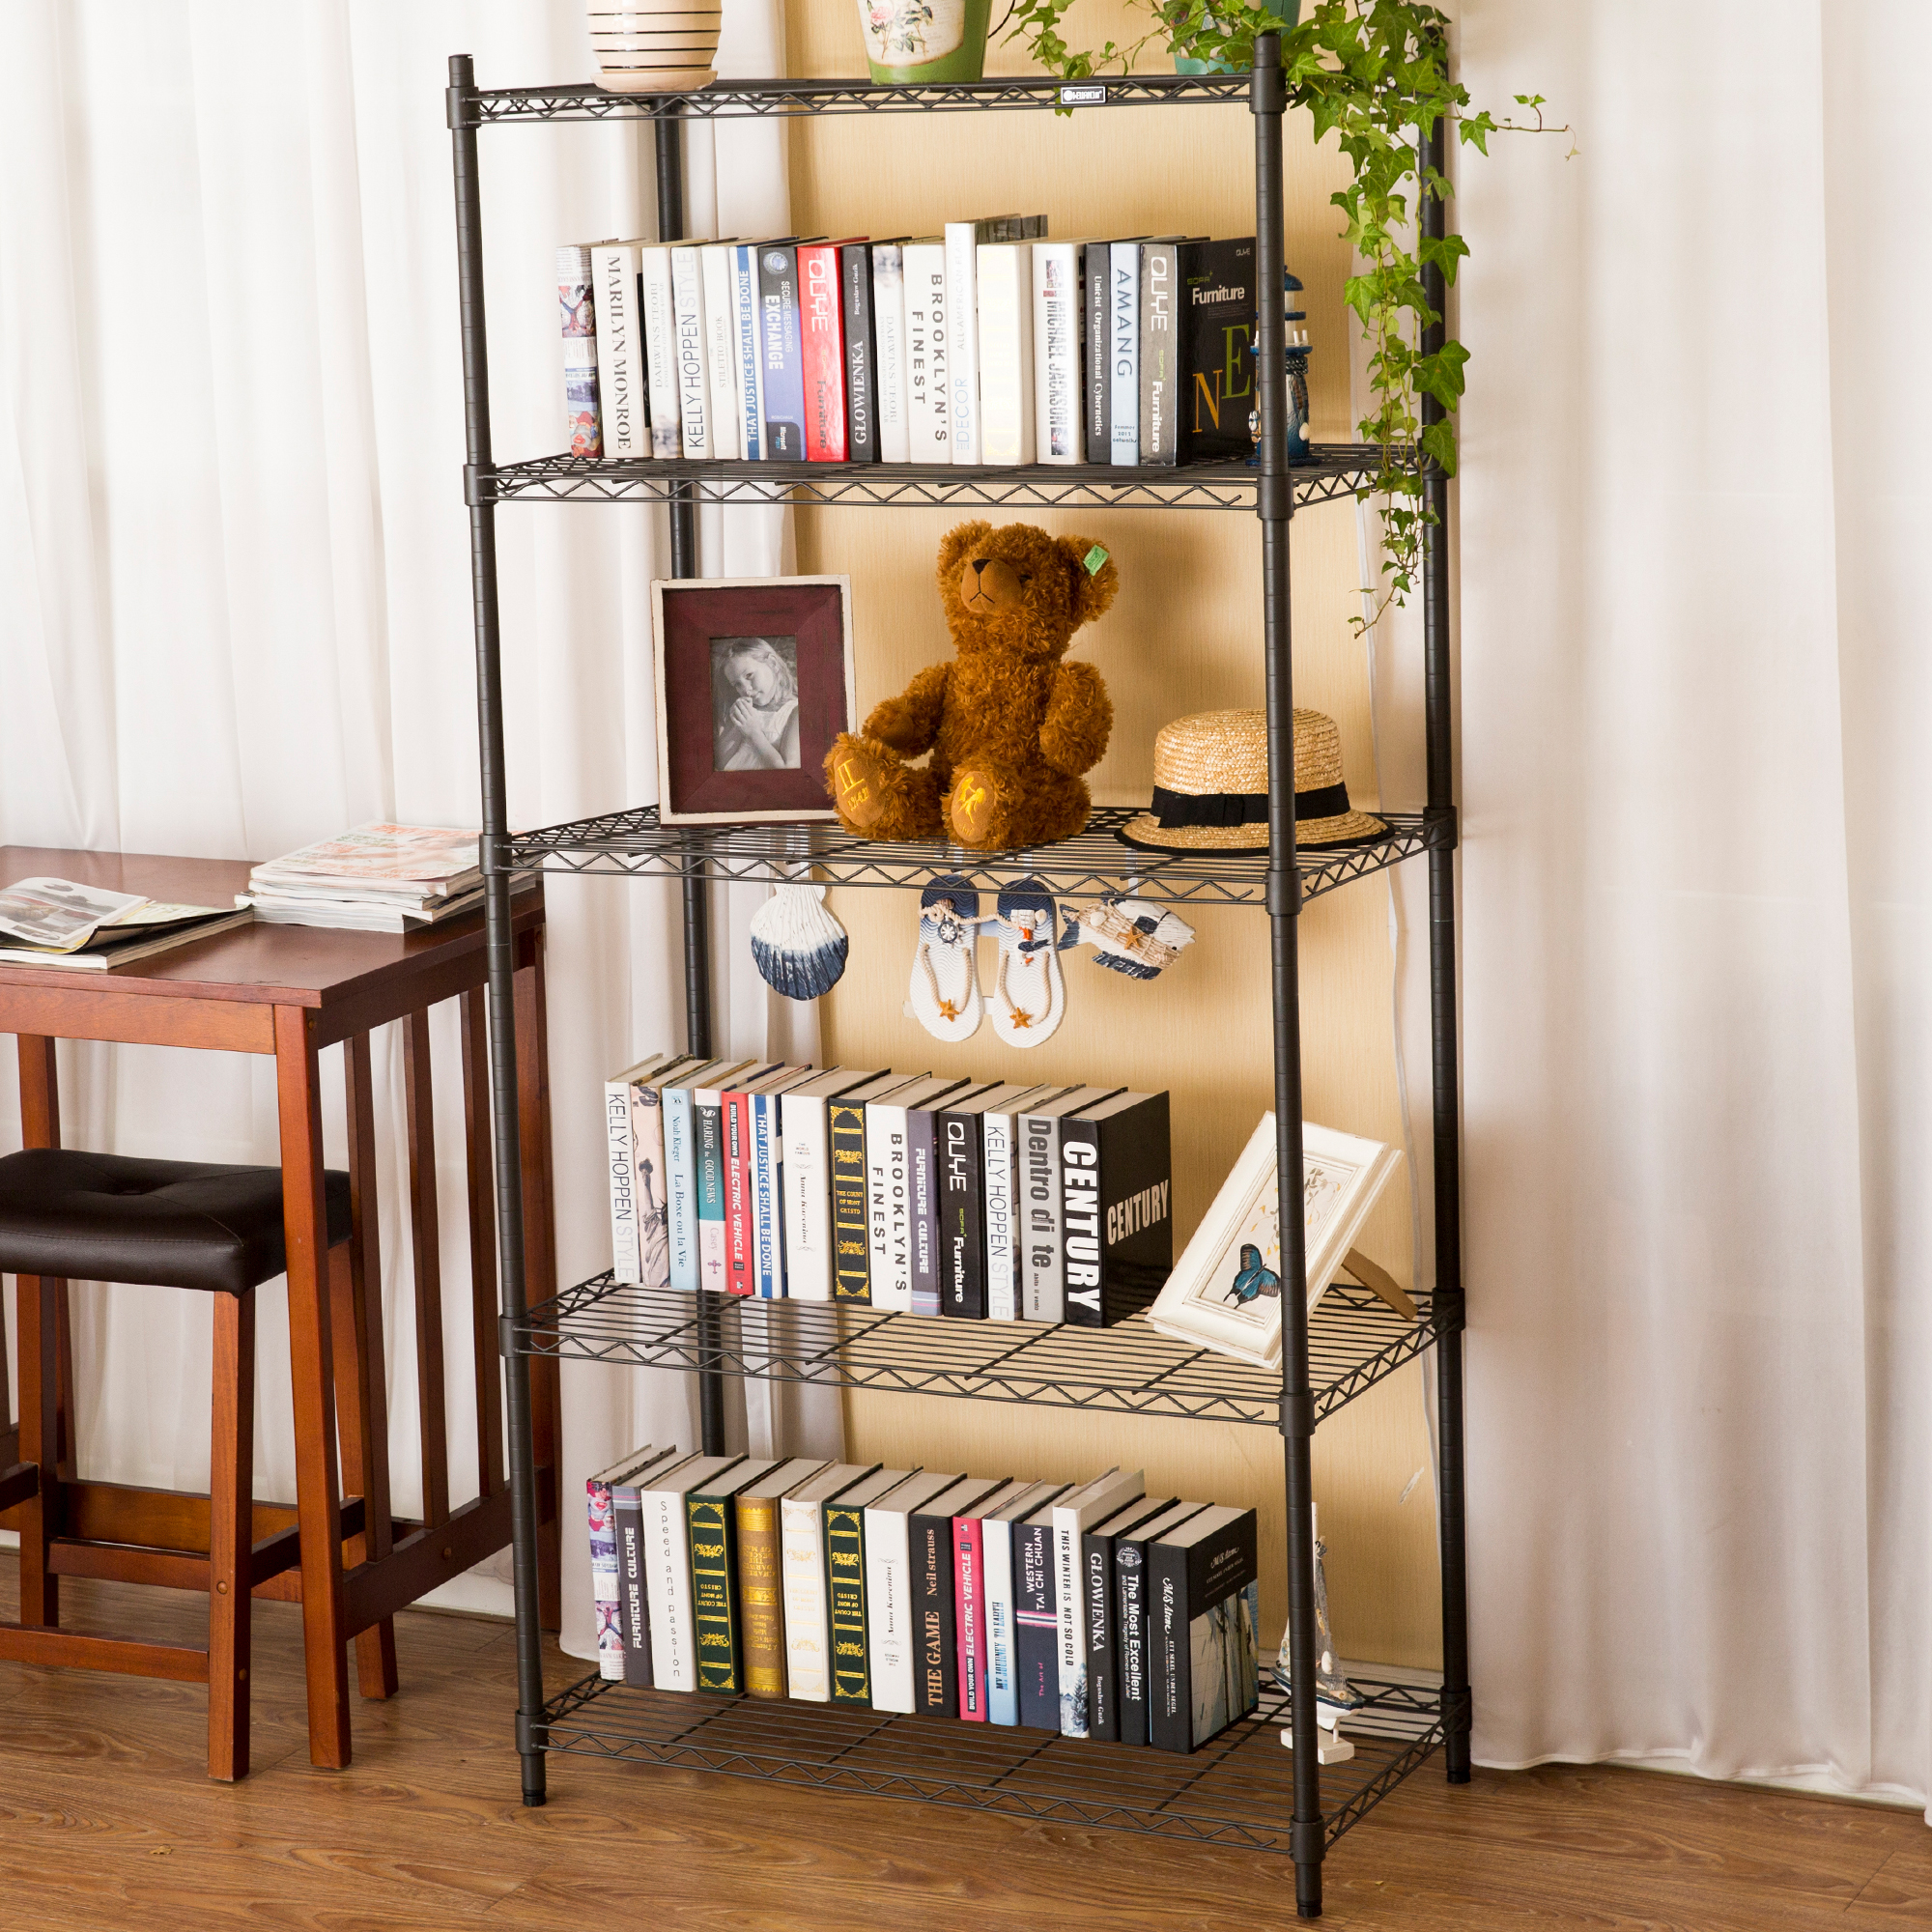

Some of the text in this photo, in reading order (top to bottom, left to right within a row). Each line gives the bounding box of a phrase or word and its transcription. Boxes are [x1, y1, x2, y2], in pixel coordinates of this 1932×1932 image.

[954, 236, 963, 265] FLAIR
[781, 281, 793, 353] SECURE MESSAGING
[1117, 269, 1133, 377] AMANG
[1192, 285, 1245, 305] Furniture
[608, 256, 631, 449] MARILYN MONROE
[650, 283, 663, 387] DARWINS TEORI
[677, 252, 704, 448] KELLY HOPPEN STYLE
[715, 316, 726, 388] STILETTO BOOK
[739, 270, 757, 441] THAT JUSTICE SHALL BE DONE
[765, 296, 784, 369] EXCHANGE
[912, 311, 925, 404] FINEST
[931, 274, 947, 440] BROOKLYN'S
[1046, 300, 1067, 427] MICHAEL JACKSON
[886, 316, 897, 423] DARWINS TEORI
[817, 380, 828, 449] Furniture
[1094, 384, 1103, 436] Cybernetics
[1151, 381, 1163, 452] Furniture
[672, 1116, 681, 1135] Noah
[608, 1094, 635, 1279] KELLY HOPPEN STYLE
[704, 1159, 715, 1181] GOOD
[706, 1181, 716, 1204] NEWS
[731, 1157, 742, 1210] ELECTRIC
[757, 1113, 772, 1276] THAT JUSTICE SHALL BE DONE
[1028, 1120, 1055, 1267] Dentro di te
[674, 1174, 687, 1267] La Boxe ou la Vie
[708, 1227, 720, 1250] Casey
[733, 1213, 743, 1261] VEHICLE
[872, 1167, 885, 1255] FINEST
[891, 1133, 906, 1291] BROOKLYN'S
[987, 1126, 1009, 1318] KELLY HOPPEN STYLE
[1064, 1141, 1101, 1312] CENTURY
[1107, 1179, 1169, 1245] CENTURY
[918, 1221, 928, 1274] CULTURE
[953, 1236, 966, 1302] Furniture
[625, 1527, 637, 1578] CULTURE
[926, 1529, 937, 1596] Neil strauss
[1025, 1543, 1035, 1593] WESTERN
[1035, 1527, 1043, 1566] CHUAN
[1061, 1530, 1069, 1551] THIS
[1062, 1553, 1071, 1589] WINTER
[660, 1500, 680, 1677] Speed and passion
[960, 1553, 973, 1601] VEHICLE
[1035, 1569, 1044, 1591] CHI
[1127, 1575, 1139, 1599] The
[963, 1603, 974, 1656] ELECTRIC
[991, 1602, 1009, 1690] MY JOURNEY TO EARTH
[1064, 1607, 1072, 1625] NOT
[1065, 1629, 1073, 1640] SO
[1128, 1604, 1140, 1636] Most
[925, 1611, 943, 1707] THE GAME
[1129, 1639, 1142, 1701] Excellent
